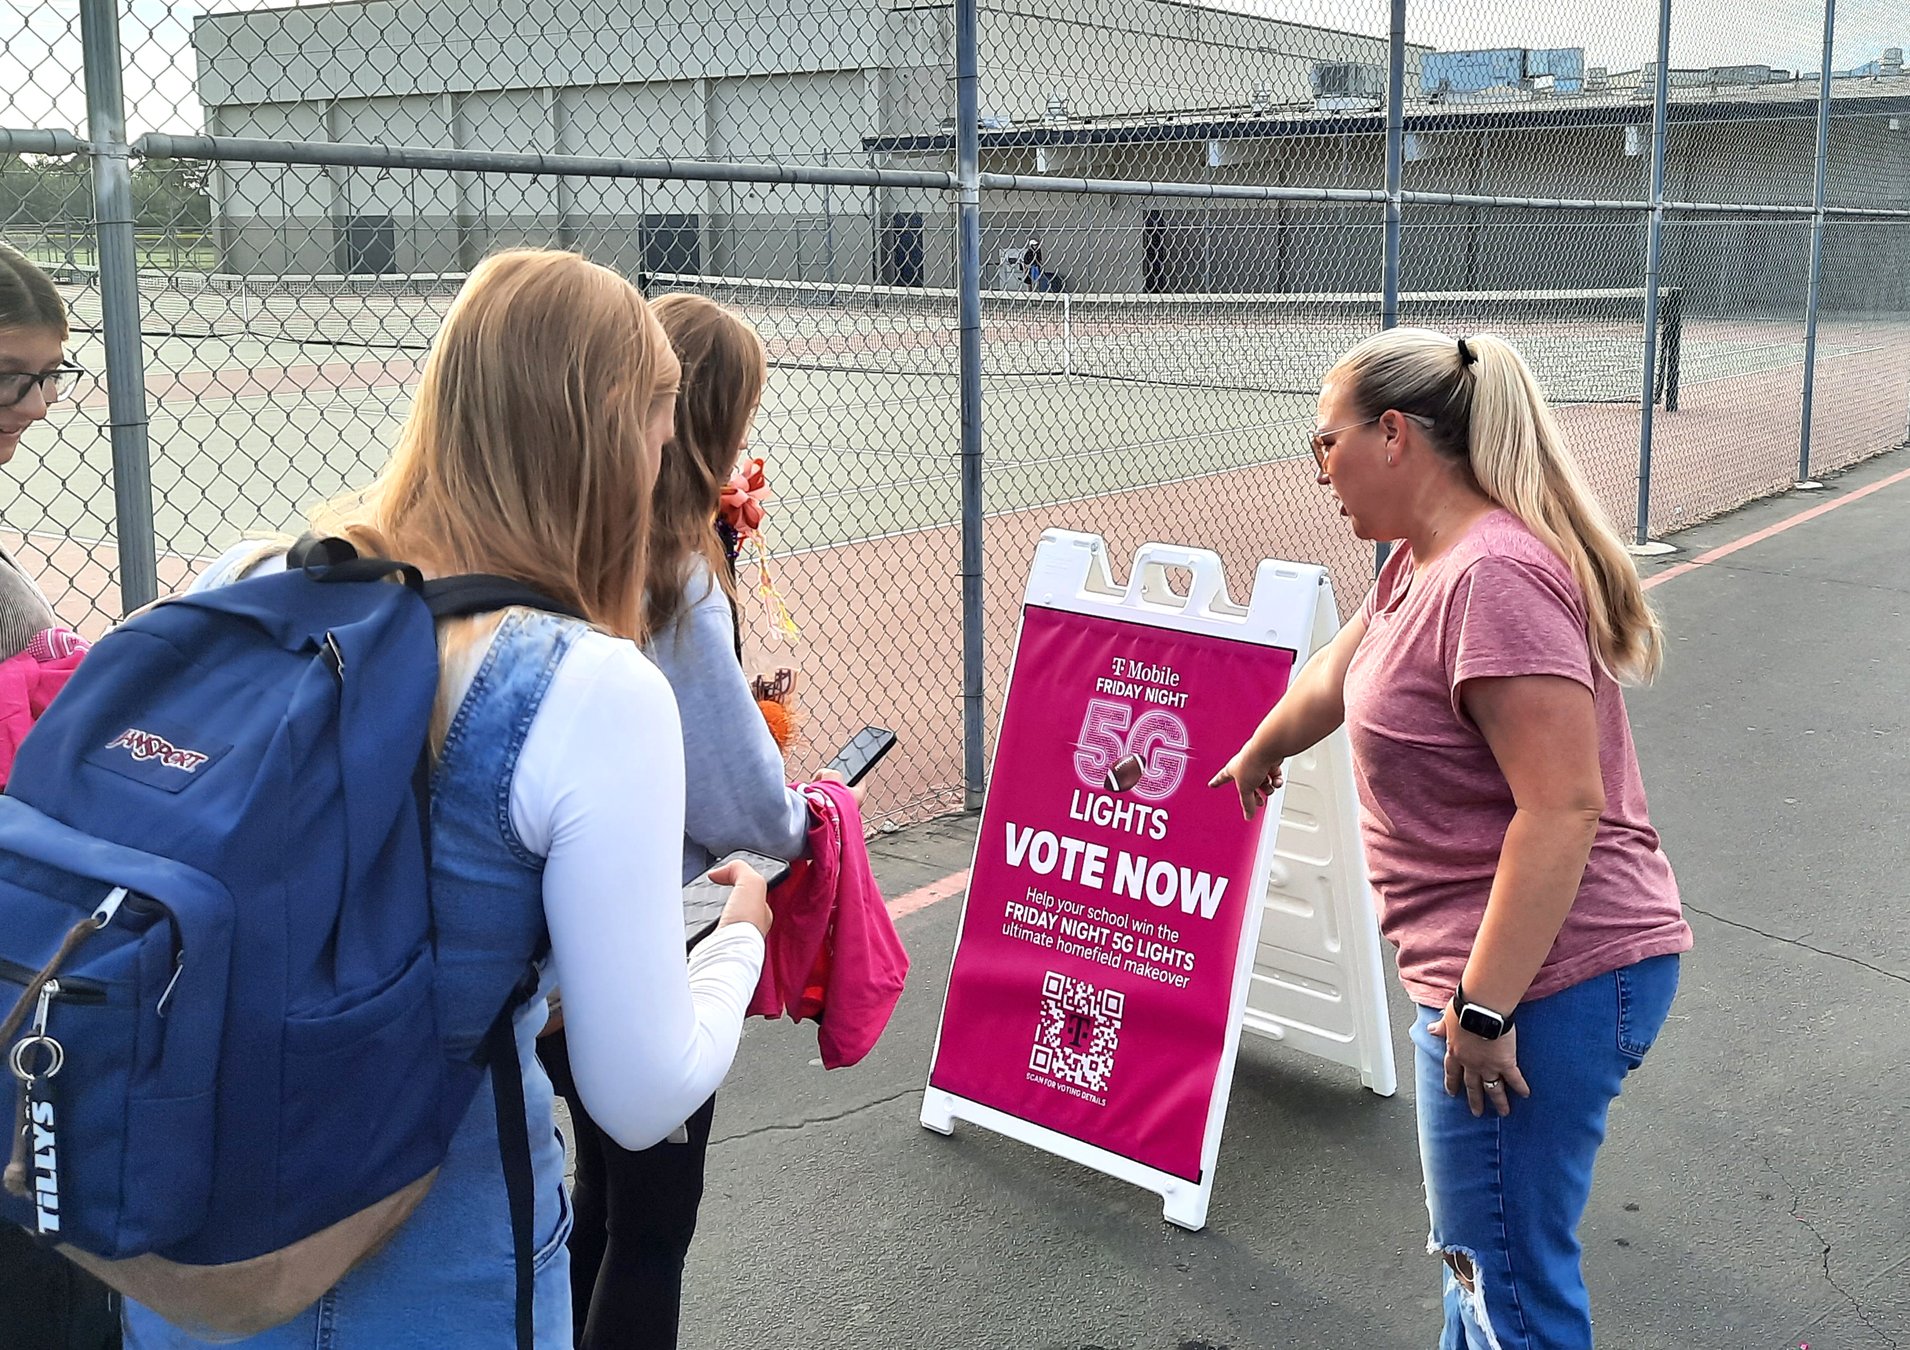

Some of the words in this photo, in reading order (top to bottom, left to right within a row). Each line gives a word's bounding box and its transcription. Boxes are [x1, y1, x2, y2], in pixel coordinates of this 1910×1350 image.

[1096, 677, 1143, 699] FRIDAY
[1144, 687, 1188, 708] NIGHT
[1127, 660, 1180, 687] Mobile
[1074, 699, 1189, 800] 5G
[1070, 789, 1169, 840] LIGHTS
[1005, 822, 1109, 889] VOTE
[1112, 851, 1229, 920] NOW
[1005, 901, 1058, 930] FRIDAY
[1060, 917, 1110, 945] NIGHT
[1112, 932, 1134, 953] 5G
[1137, 938, 1195, 971] LIGHTS
[1026, 887, 1054, 908] Help
[1057, 898, 1085, 916] your
[1087, 906, 1129, 929] school
[1132, 919, 1154, 936] win
[1157, 924, 1179, 943] the
[1002, 922, 1054, 948] ultimate
[1056, 938, 1122, 968] homefield
[1123, 958, 1191, 989] makeover
[1026, 1072, 1044, 1085] SCAN
[1043, 1078, 1057, 1089] FOR
[1057, 1082, 1081, 1097] VOTING
[1081, 1091, 1107, 1107] DETAILS
